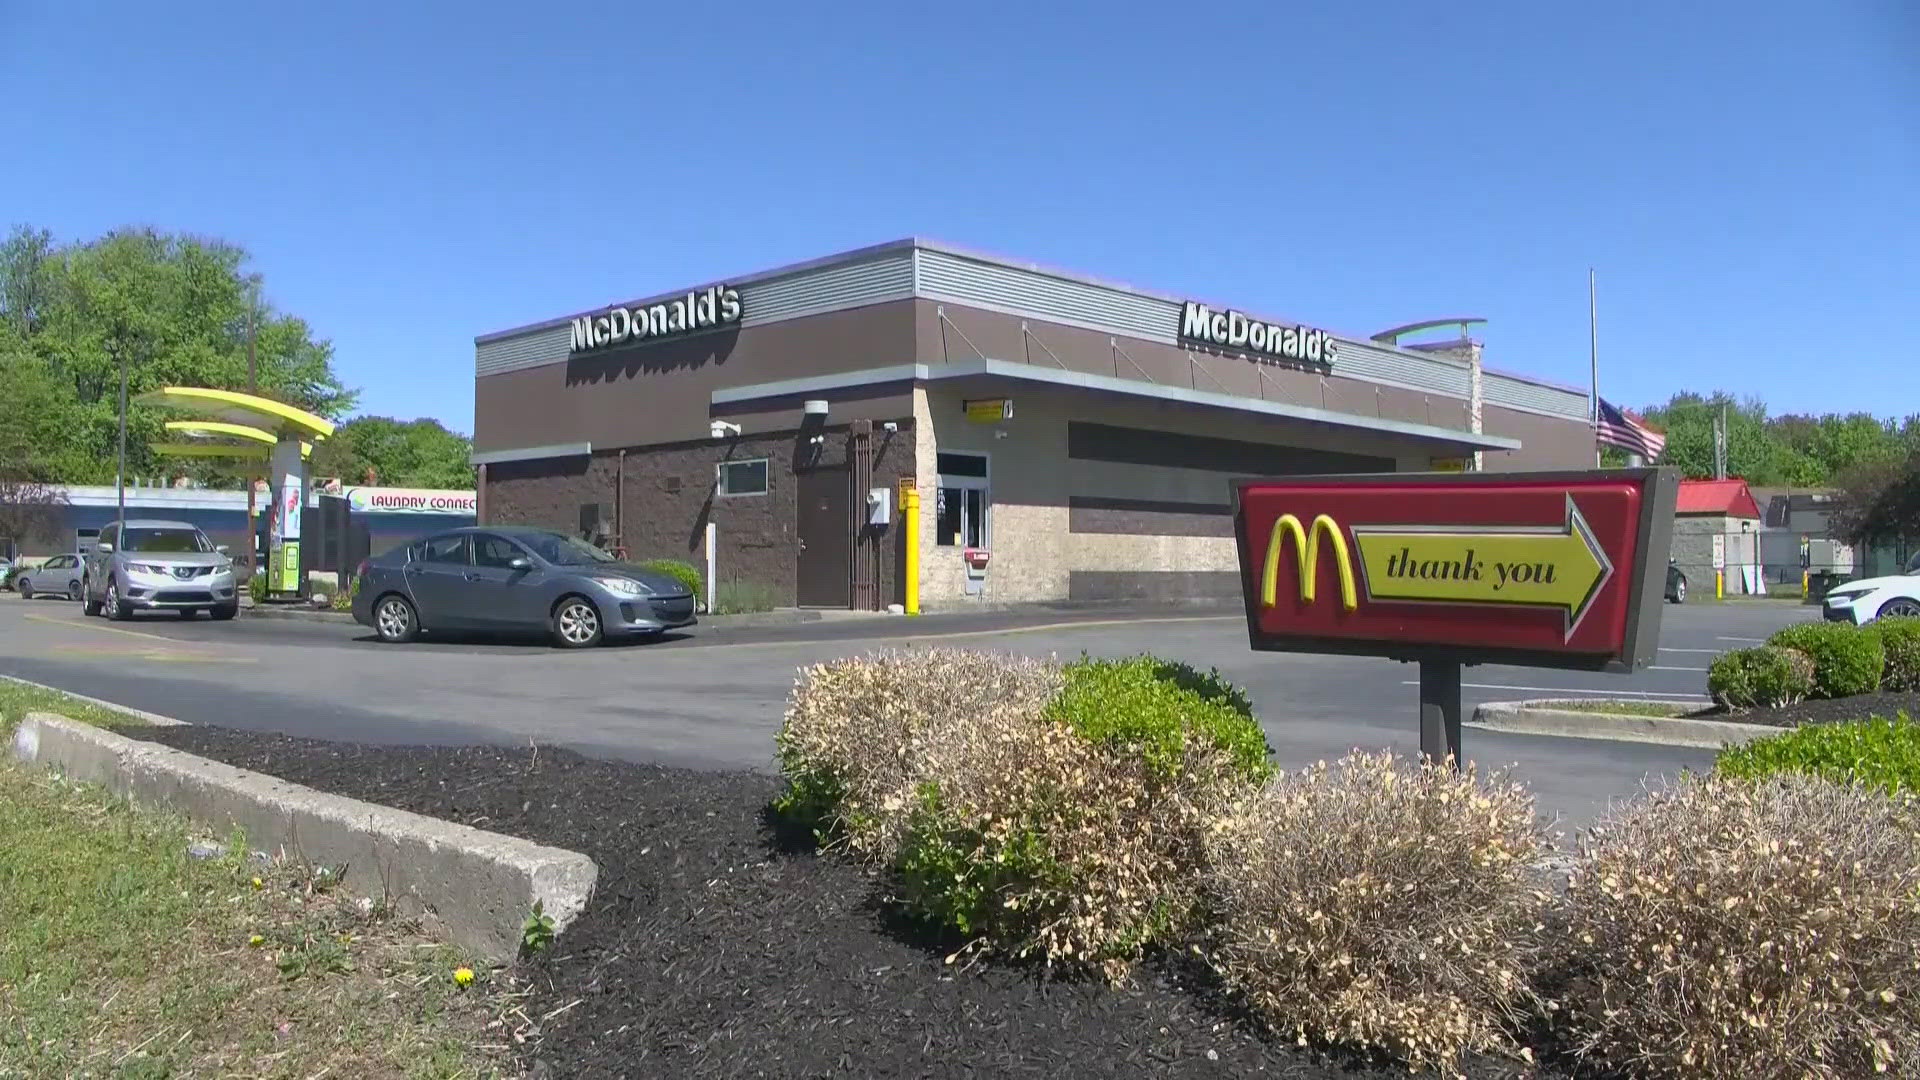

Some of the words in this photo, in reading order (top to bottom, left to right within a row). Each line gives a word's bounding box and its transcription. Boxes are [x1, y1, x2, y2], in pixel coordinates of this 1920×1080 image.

[570, 285, 741, 353] McDonald's
[1183, 302, 1339, 366] McDonald's
[371, 495, 426, 508] LAUNDRY
[1386, 547, 1484, 581] thank
[1492, 561, 1557, 591] you
